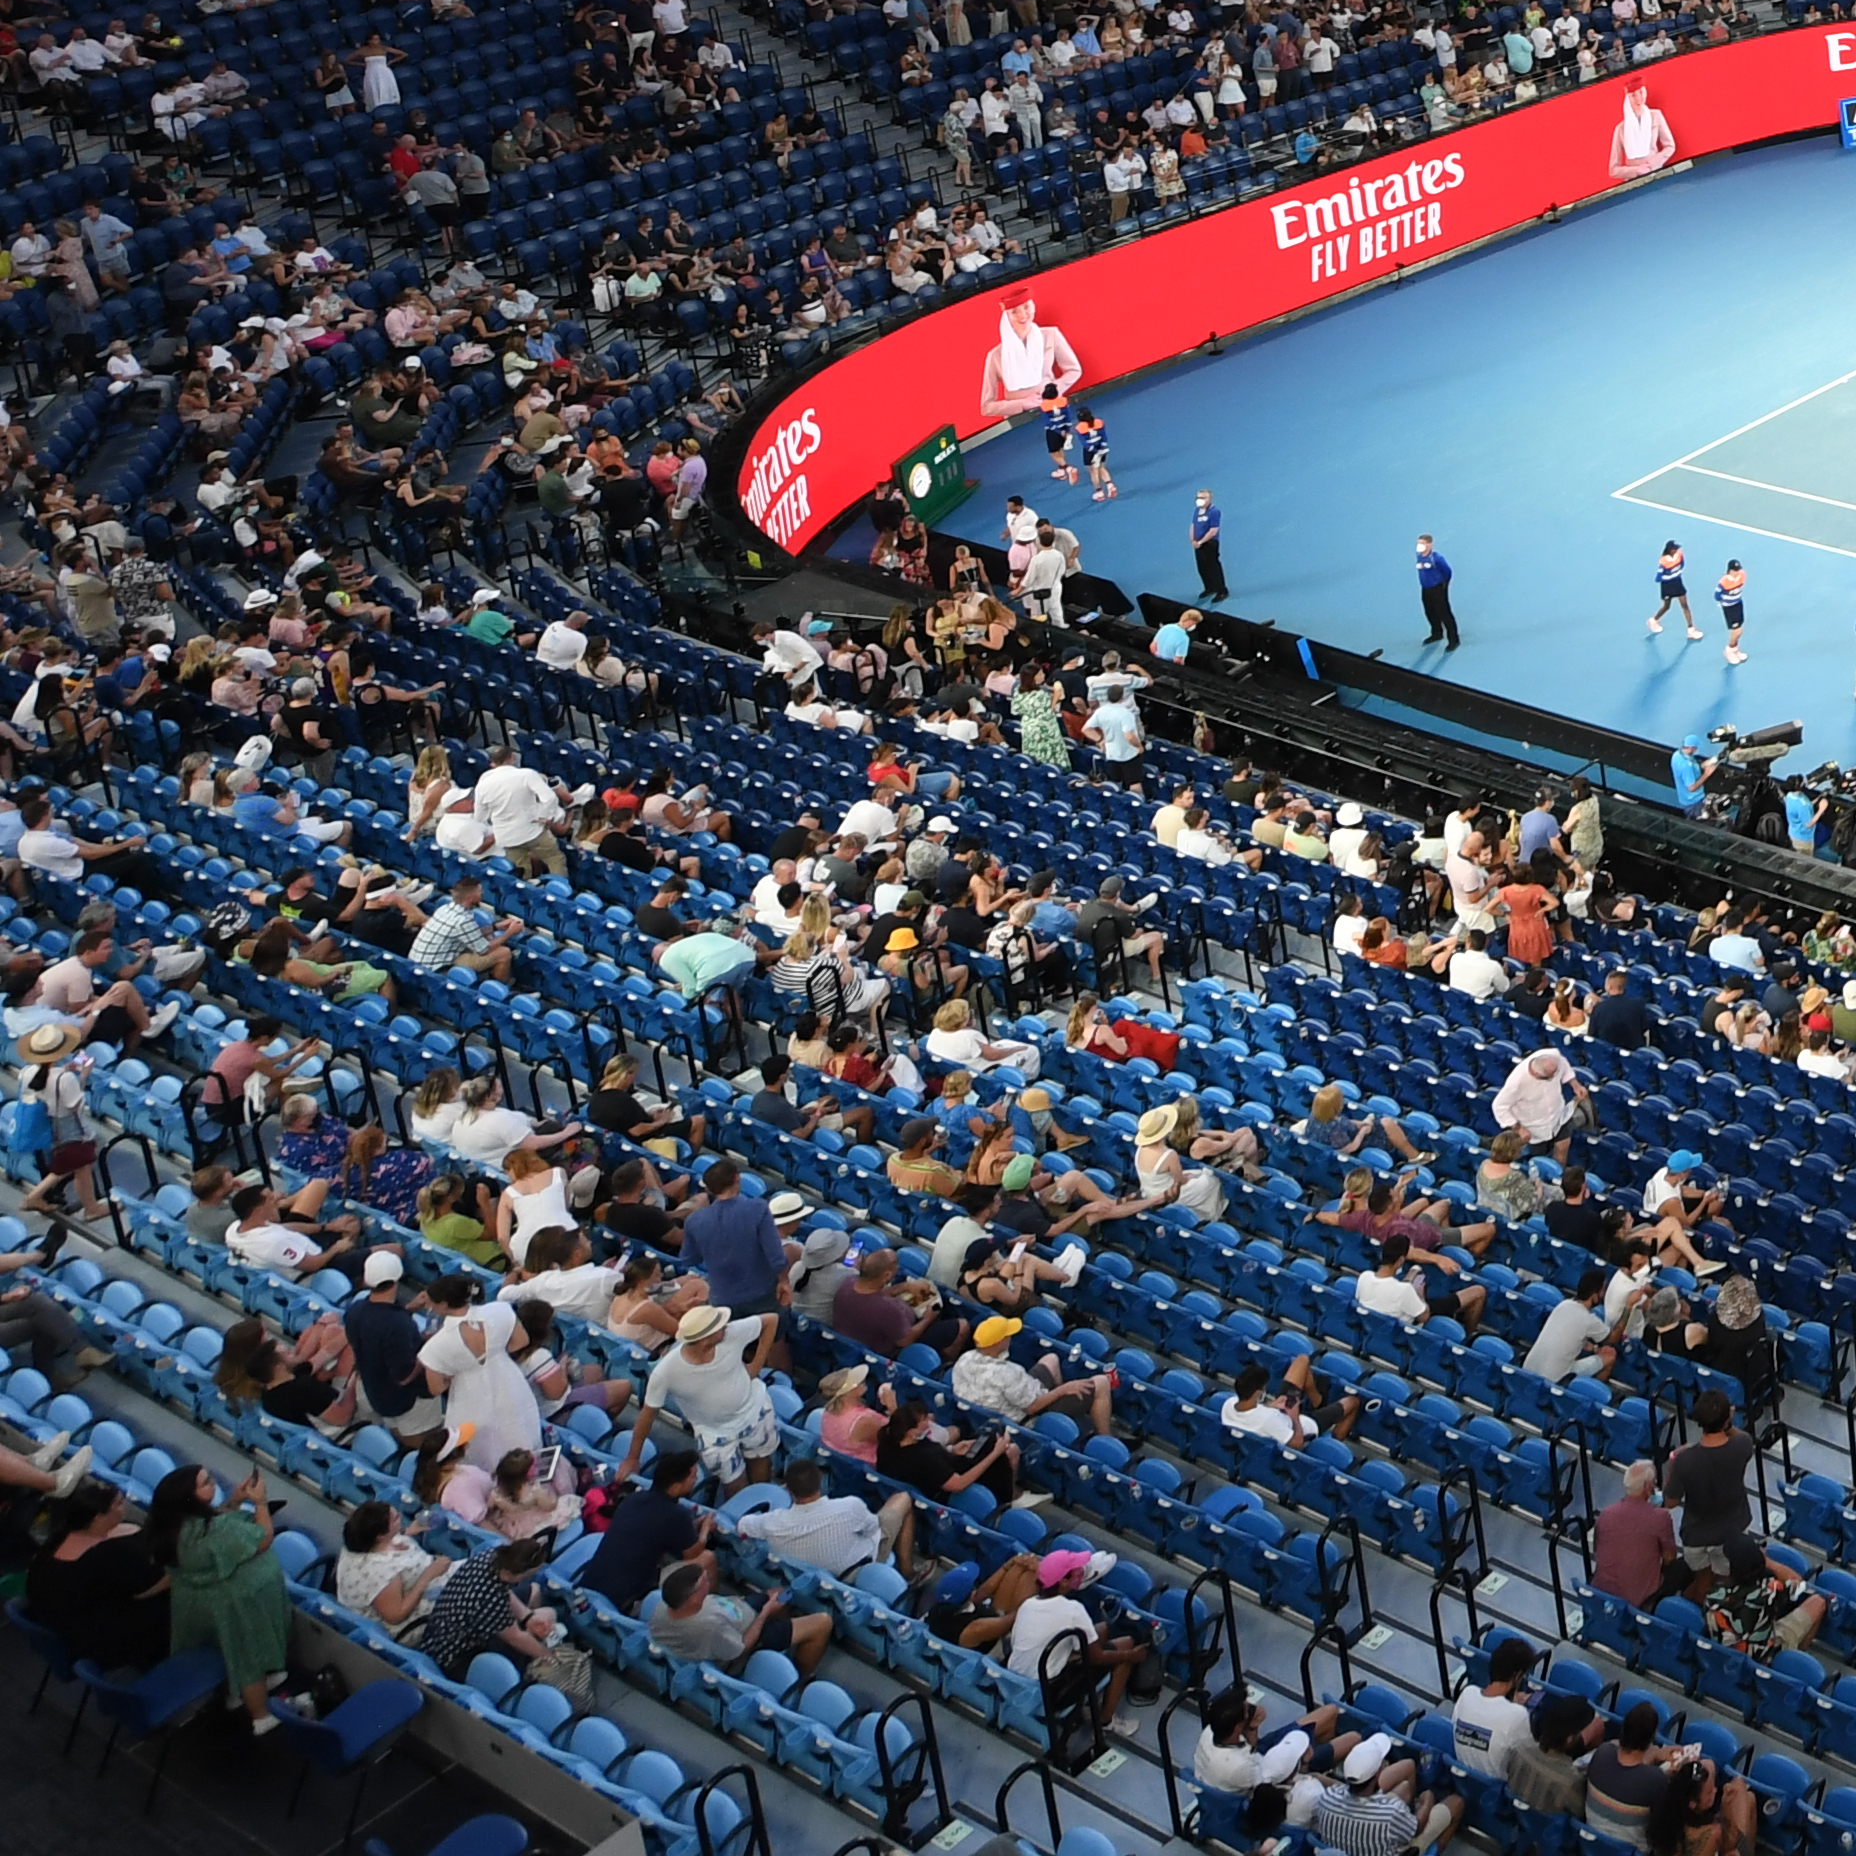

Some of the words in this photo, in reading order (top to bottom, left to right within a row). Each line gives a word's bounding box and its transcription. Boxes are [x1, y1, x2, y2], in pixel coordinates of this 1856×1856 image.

[1271, 152, 1466, 251] Emirates
[1309, 232, 1355, 283] FLY
[1357, 201, 1444, 267] BETTER
[741, 408, 822, 527] mirates
[934, 443, 957, 465] ROLEX
